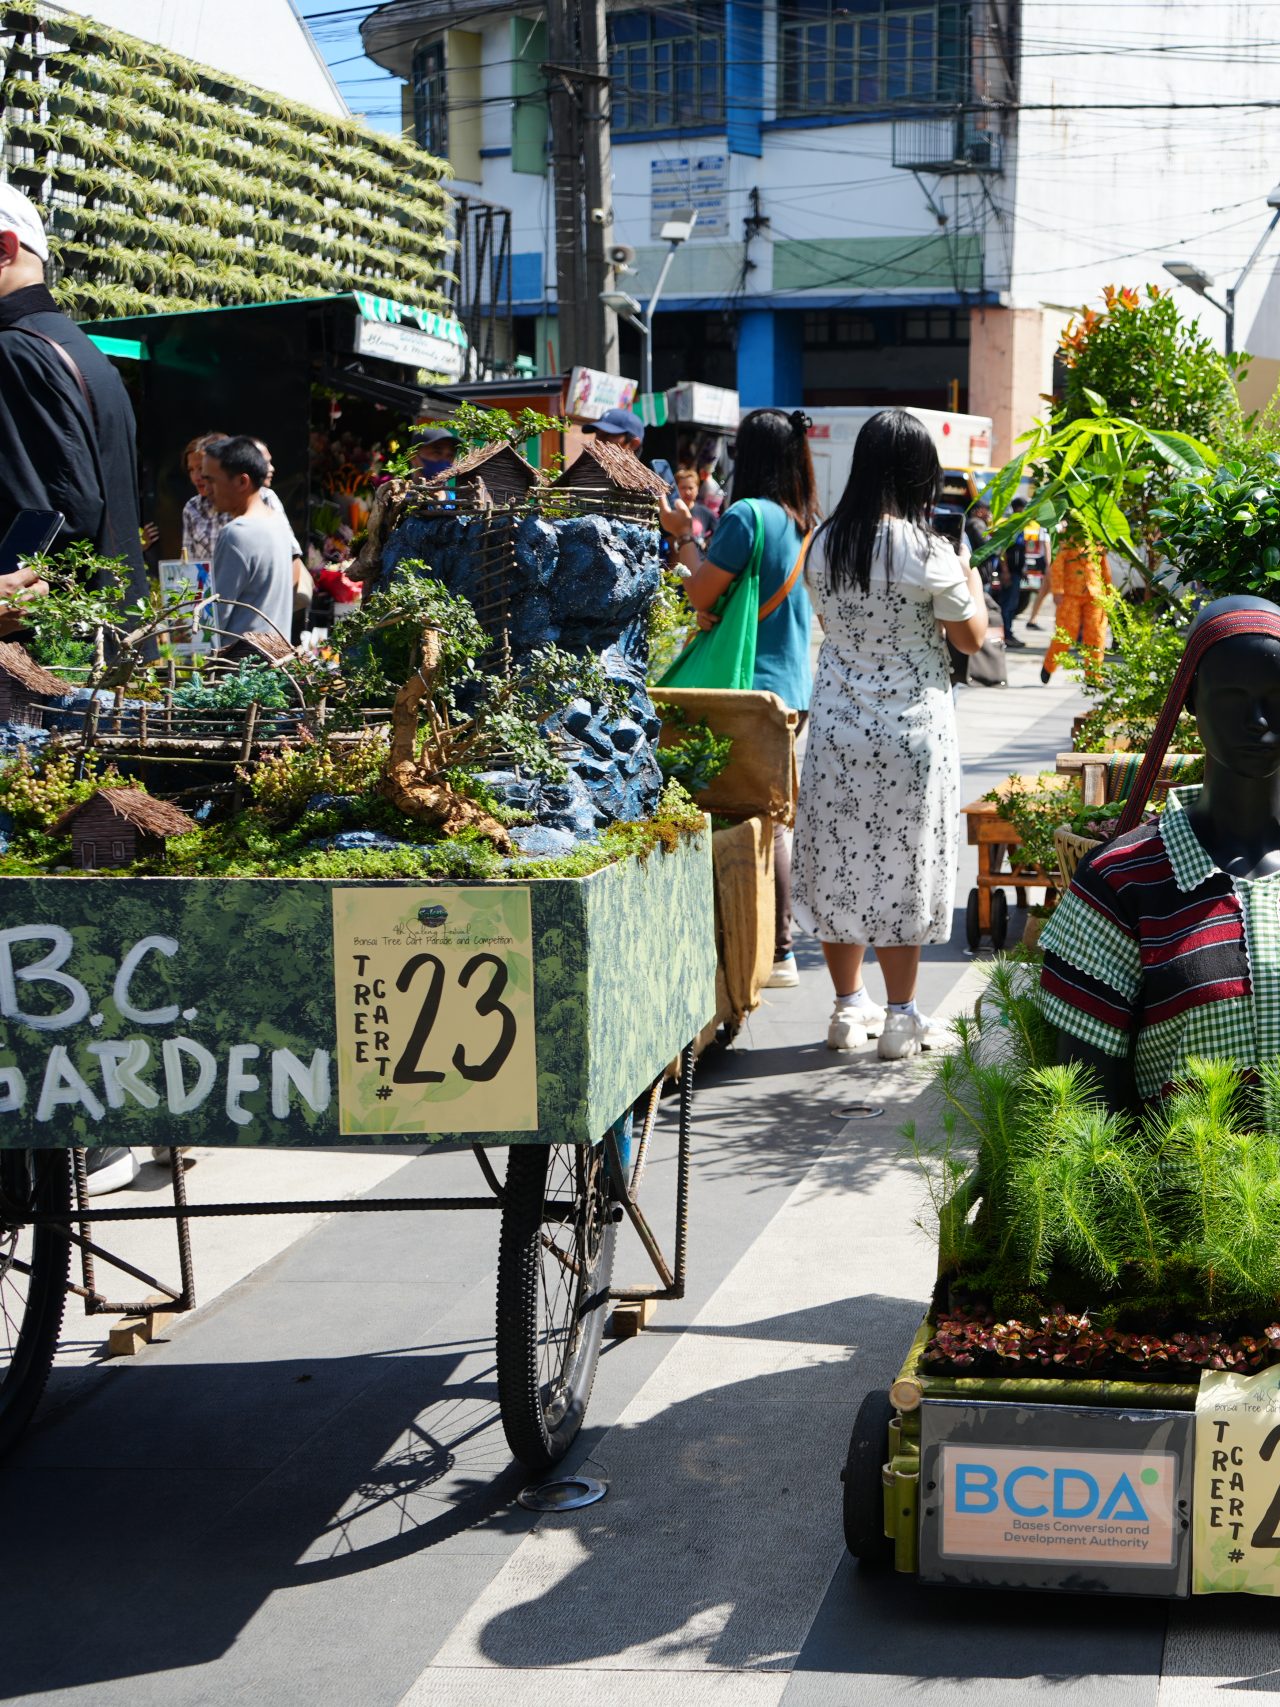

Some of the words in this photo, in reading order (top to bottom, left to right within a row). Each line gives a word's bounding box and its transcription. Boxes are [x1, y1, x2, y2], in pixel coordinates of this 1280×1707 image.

[0, 923, 198, 1031] B.C.
[353, 937, 378, 946] Bonsai
[382, 936, 402, 946] Tree
[406, 936, 422, 946] Cart
[426, 937, 453, 946] Parade
[456, 936, 470, 945] and
[474, 936, 513, 947] Competition
[352, 955, 371, 1063] TREE
[372, 979, 391, 1076] CART
[393, 952, 516, 1084] 23
[1243, 1402, 1261, 1413] Tree
[955, 1463, 1149, 1522] BCDA
[1210, 1421, 1230, 1527] TREE
[1228, 1446, 1244, 1540] CART
[1004, 1532, 1086, 1546] Development
[1089, 1537, 1149, 1550] Authority
[1012, 1520, 1050, 1531] Bases
[1053, 1521, 1123, 1534] Conversion
[1125, 1526, 1150, 1535] and
